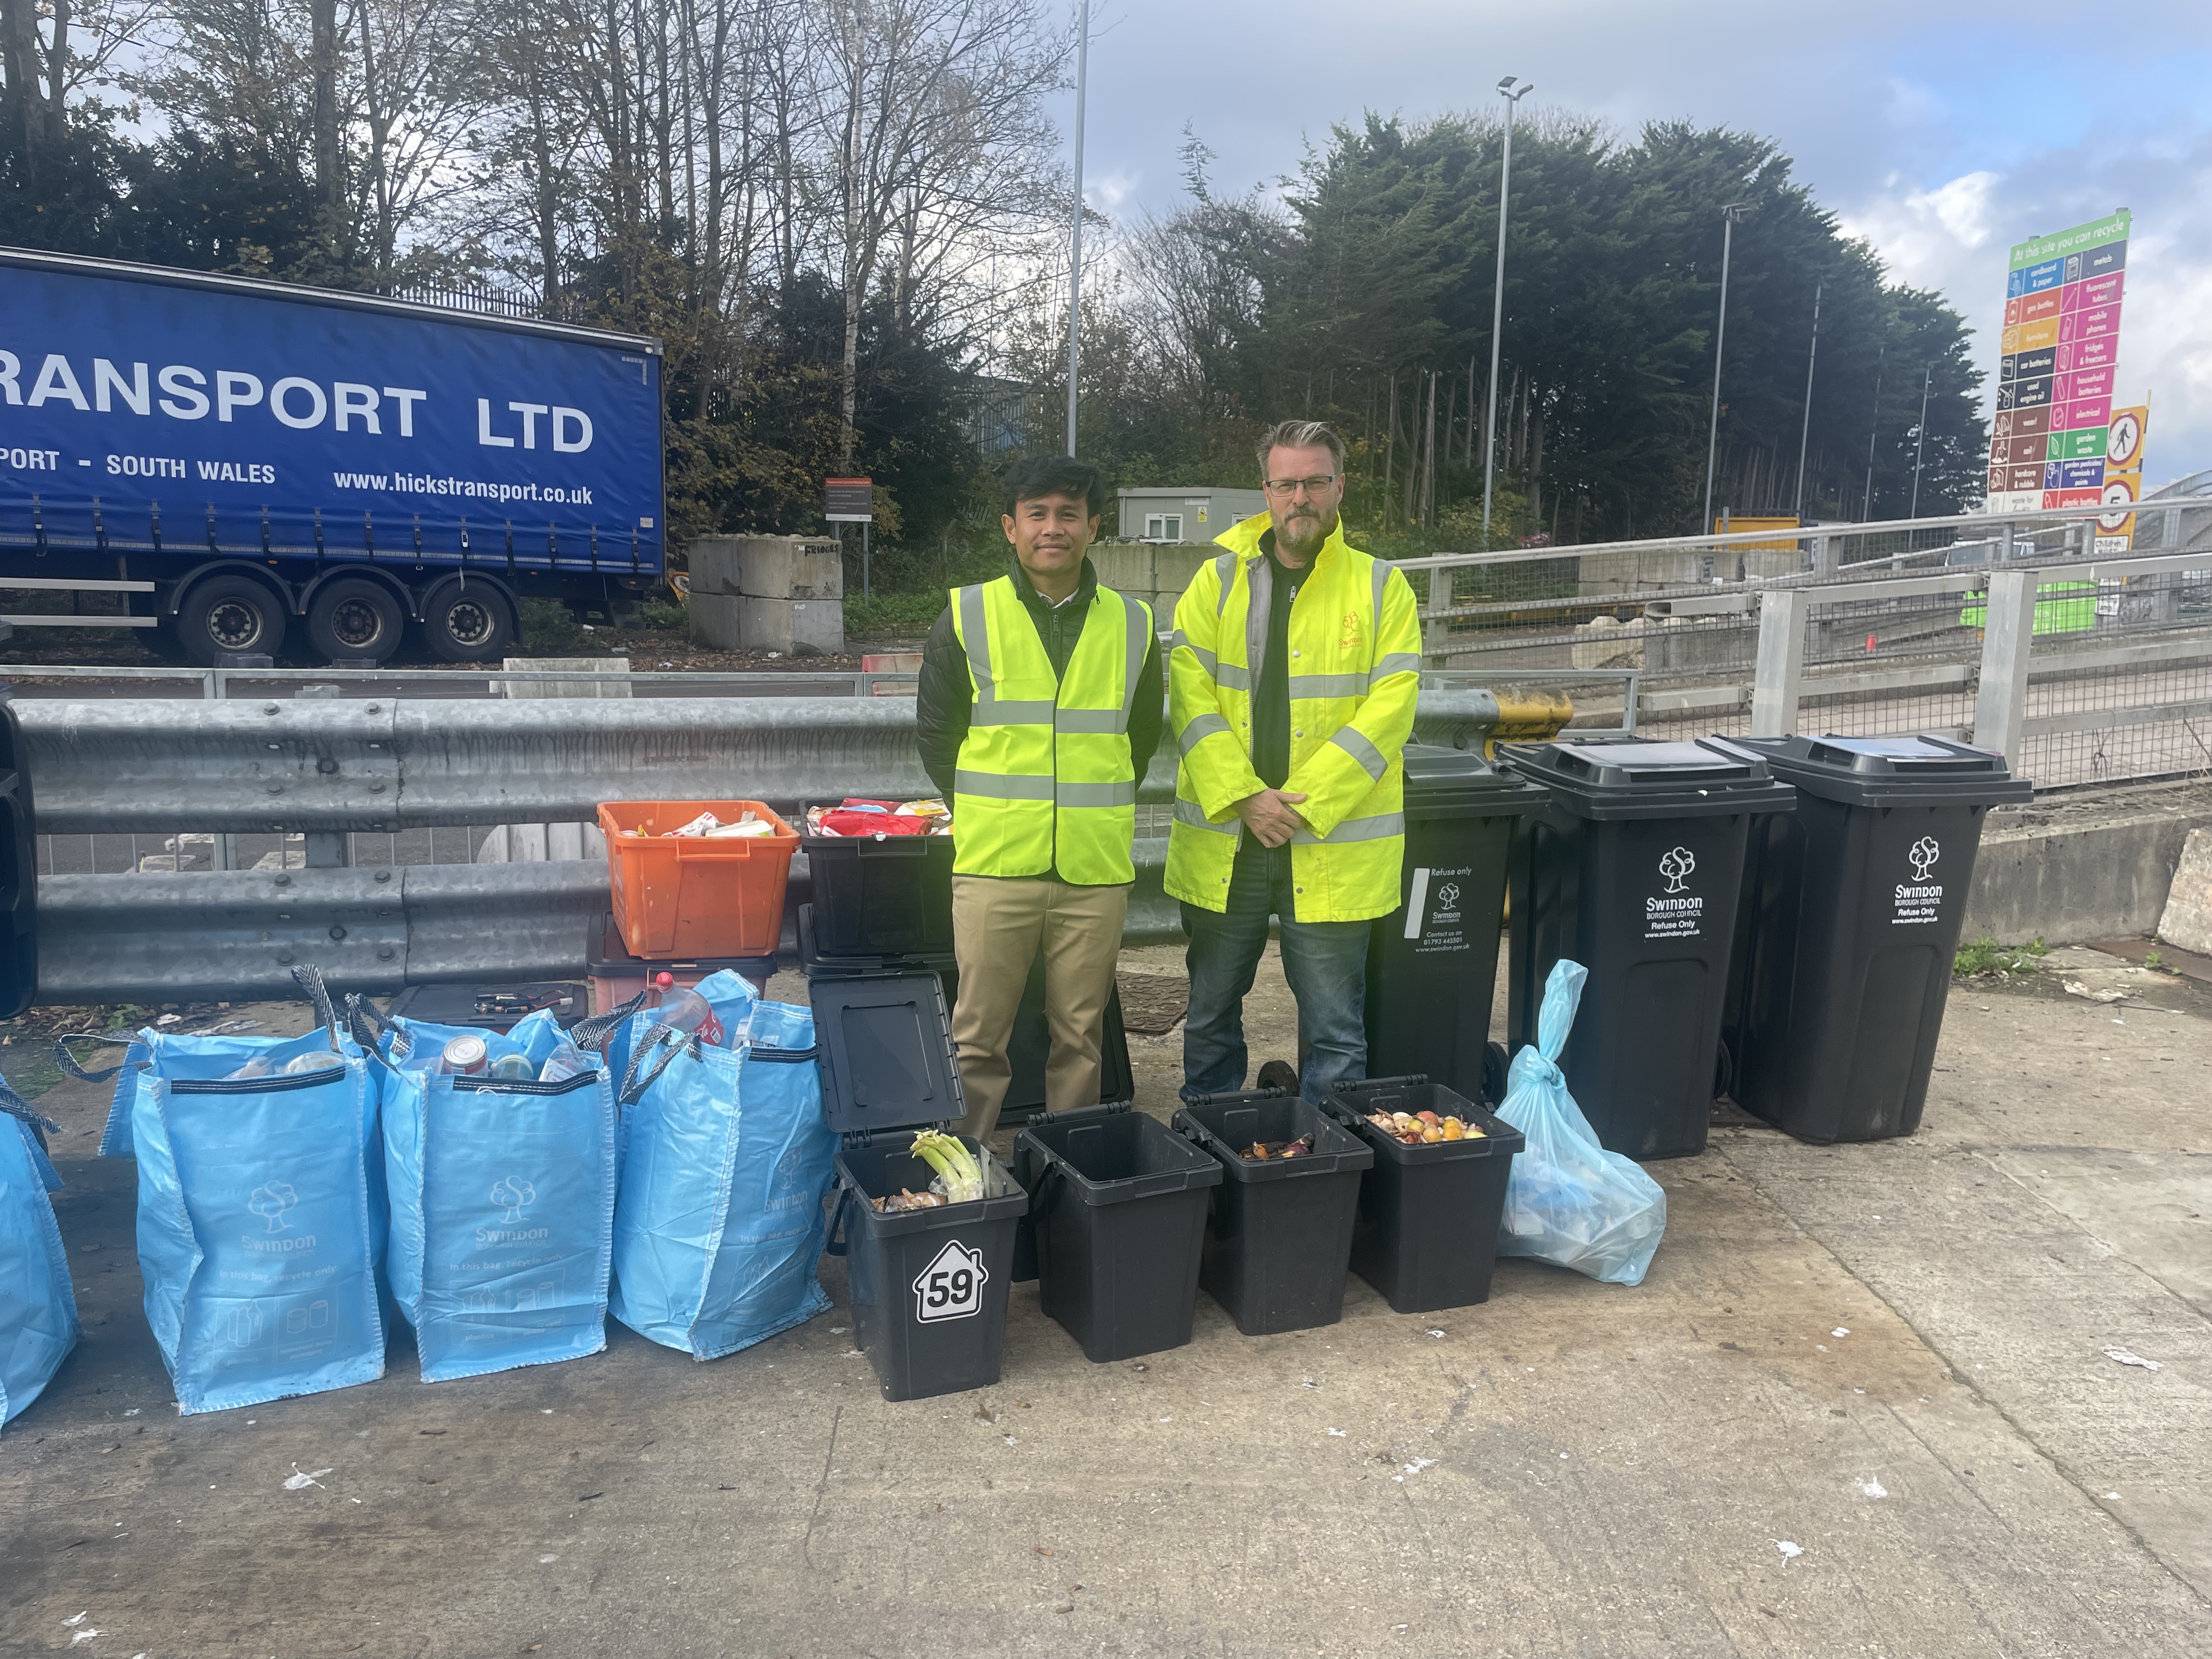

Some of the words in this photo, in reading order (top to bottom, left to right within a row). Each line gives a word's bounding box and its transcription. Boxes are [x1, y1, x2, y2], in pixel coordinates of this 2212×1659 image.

[2014, 250, 2023, 262] At
[2025, 245, 2039, 258] this
[2041, 241, 2056, 253] site
[2058, 237, 2073, 252] you
[2075, 232, 2090, 244] can
[2093, 218, 2124, 238] recycle
[2094, 254, 2113, 267] metals
[2031, 263, 2057, 277] cardboard
[2038, 277, 2053, 289] paper
[2086, 279, 2117, 293] fluorescent
[2092, 294, 2108, 303] tubes
[2088, 311, 2107, 322] mobile
[2086, 324, 2107, 336] phones
[2085, 343, 2104, 353] fridges
[2029, 357, 2051, 368] batteries
[2079, 357, 2084, 365] &
[2085, 354, 2107, 364] freezers
[2077, 372, 2106, 384] household
[2027, 381, 2040, 391] used
[2078, 386, 2102, 396] batteries
[2019, 393, 2037, 404] engine
[2076, 407, 2100, 419] electrical
[478, 398, 594, 453] LTD
[2076, 433, 2096, 445] garden
[2077, 446, 2093, 455] waste
[107, 454, 186, 478] SOUTH
[198, 461, 275, 484] WALES
[2015, 469, 2036, 478] hardcore
[334, 472, 593, 505] www.hickstransport.co.uk
[2019, 479, 2035, 488] rubble
[1431, 868, 1455, 877] Refuse
[1457, 866, 1472, 876] only
[1646, 911, 1675, 919] BOROUGH
[1921, 907, 1935, 916] Only
[1651, 922, 1677, 930] Refuse
[1678, 919, 1696, 929] Only
[1645, 929, 1700, 938] www.swindon.gov.uk
[1415, 943, 1470, 952] www.swindon.gov.uk
[506, 1257, 541, 1268] recycle
[219, 1269, 229, 1278] In
[231, 1270, 249, 1280] this
[275, 1271, 312, 1282] recycle
[927, 1269, 973, 1308] 59
